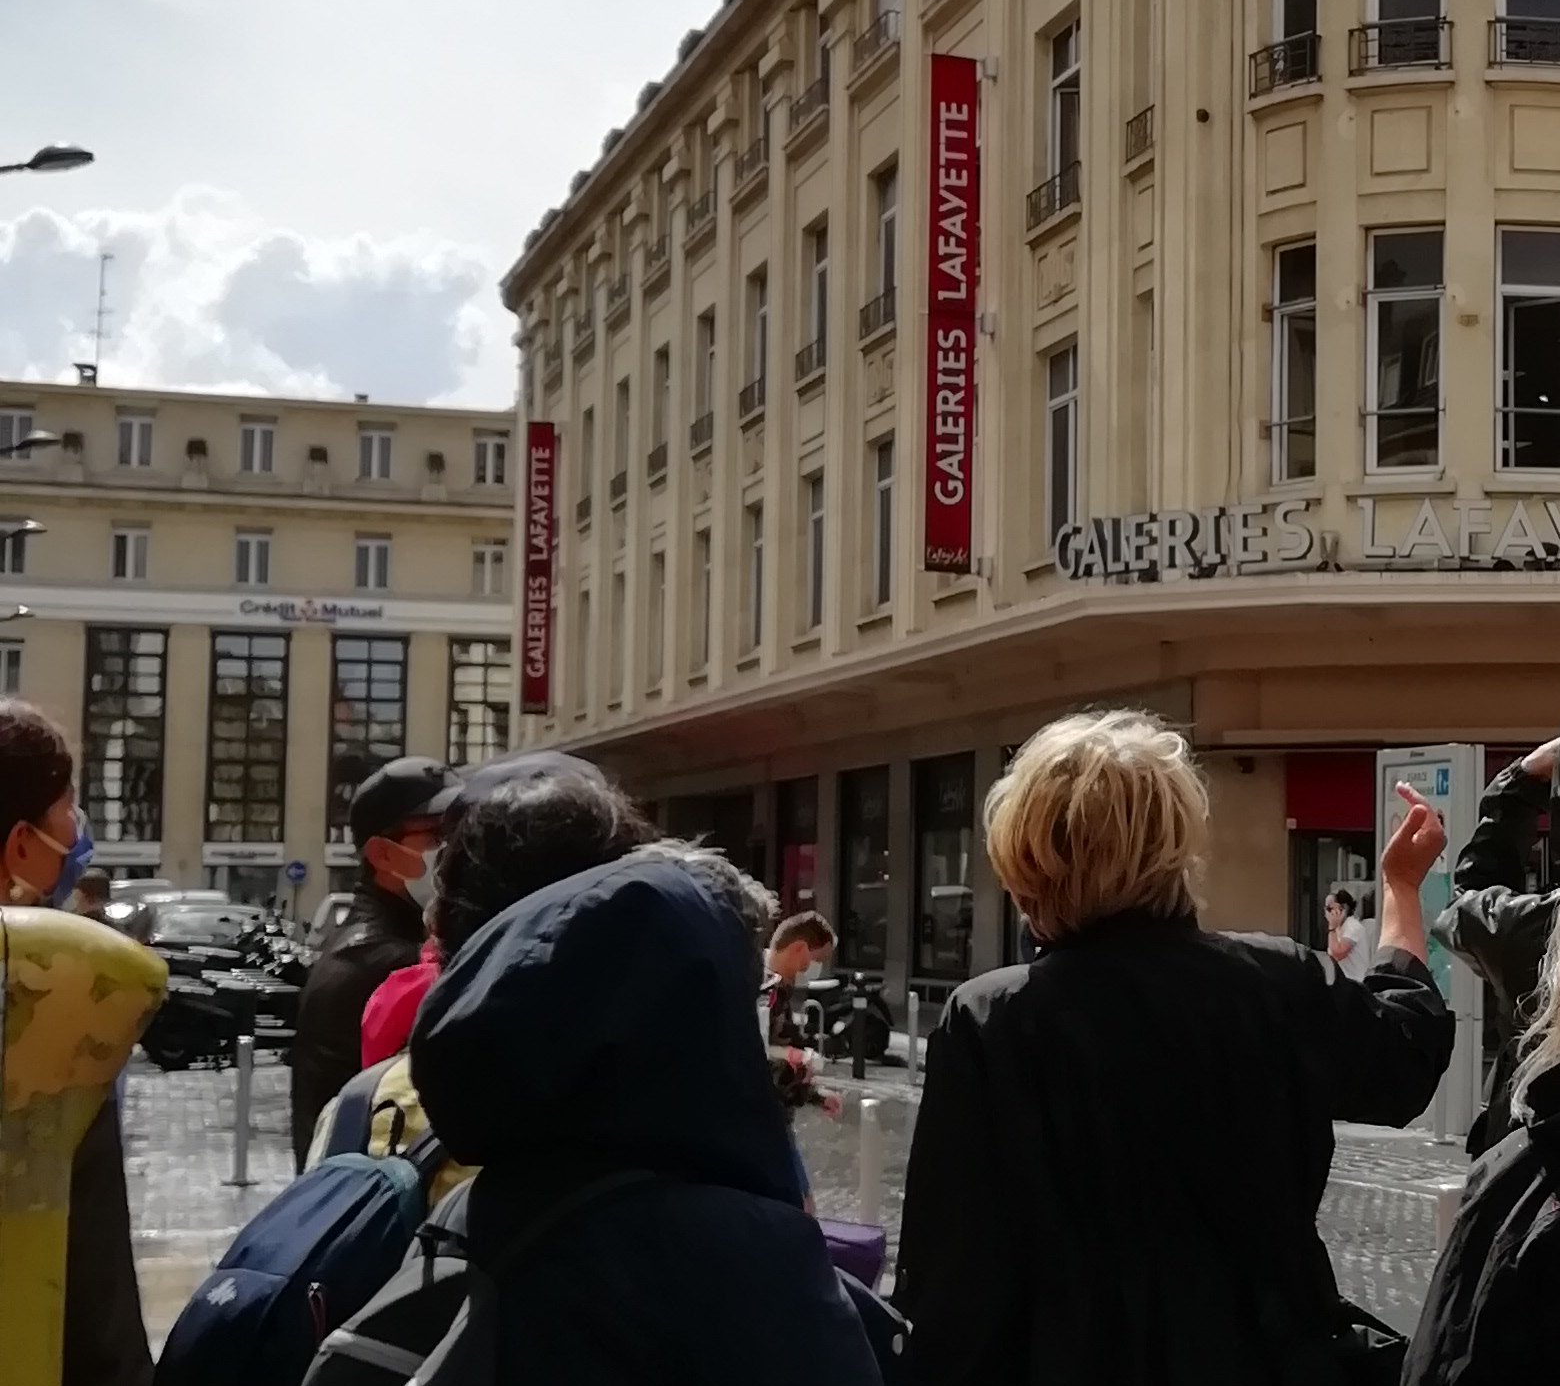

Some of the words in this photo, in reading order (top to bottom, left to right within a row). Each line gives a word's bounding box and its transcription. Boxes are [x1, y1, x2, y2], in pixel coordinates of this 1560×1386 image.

[936, 100, 969, 302] LAFAYETTE
[934, 327, 968, 507] GALERIES
[528, 445, 551, 562] LAFAYETTE
[1054, 499, 1314, 579] GALERIES
[526, 575, 547, 678] GALERIES
